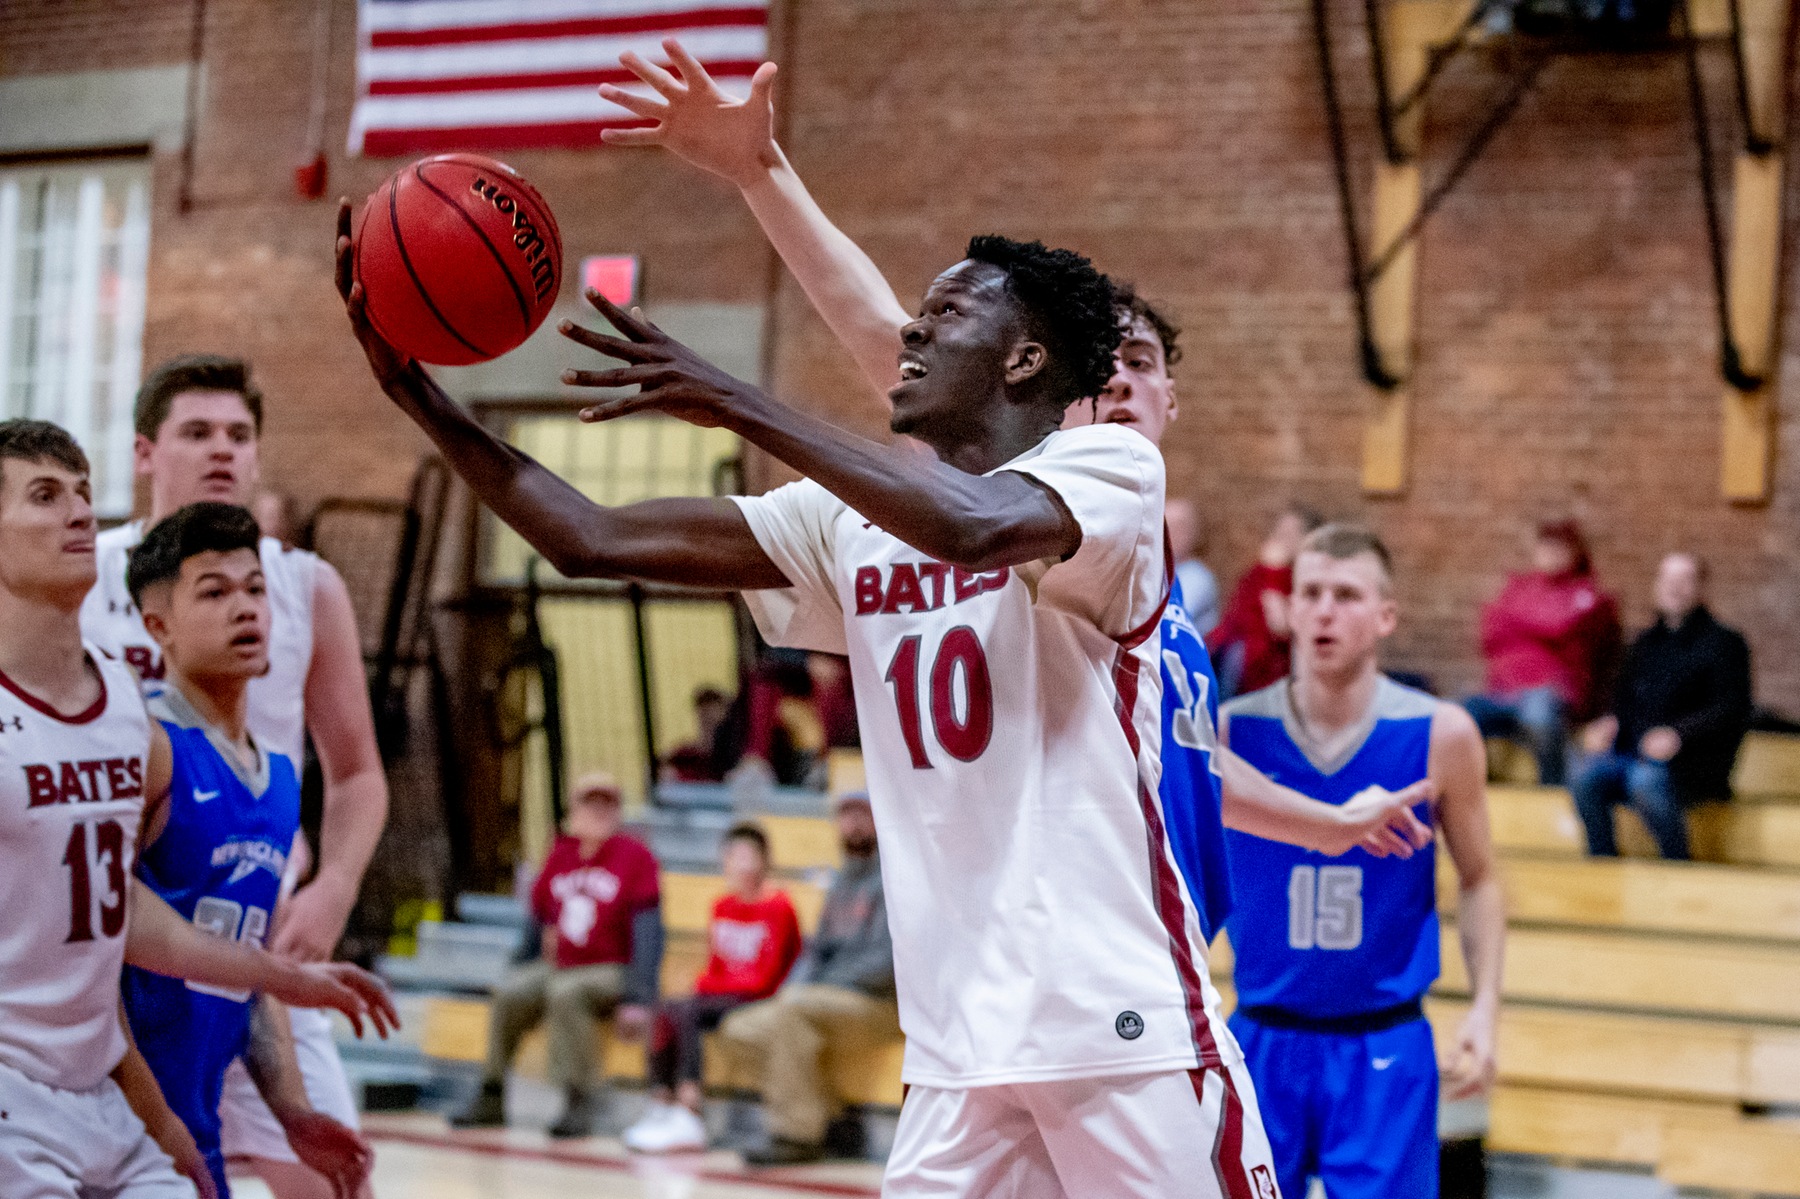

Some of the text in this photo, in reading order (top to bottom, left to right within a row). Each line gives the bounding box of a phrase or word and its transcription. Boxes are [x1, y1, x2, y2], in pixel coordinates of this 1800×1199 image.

[885, 624, 994, 770] 10
[22, 756, 143, 809] BATES
[62, 818, 126, 944] 13
[1288, 865, 1363, 949] 15
